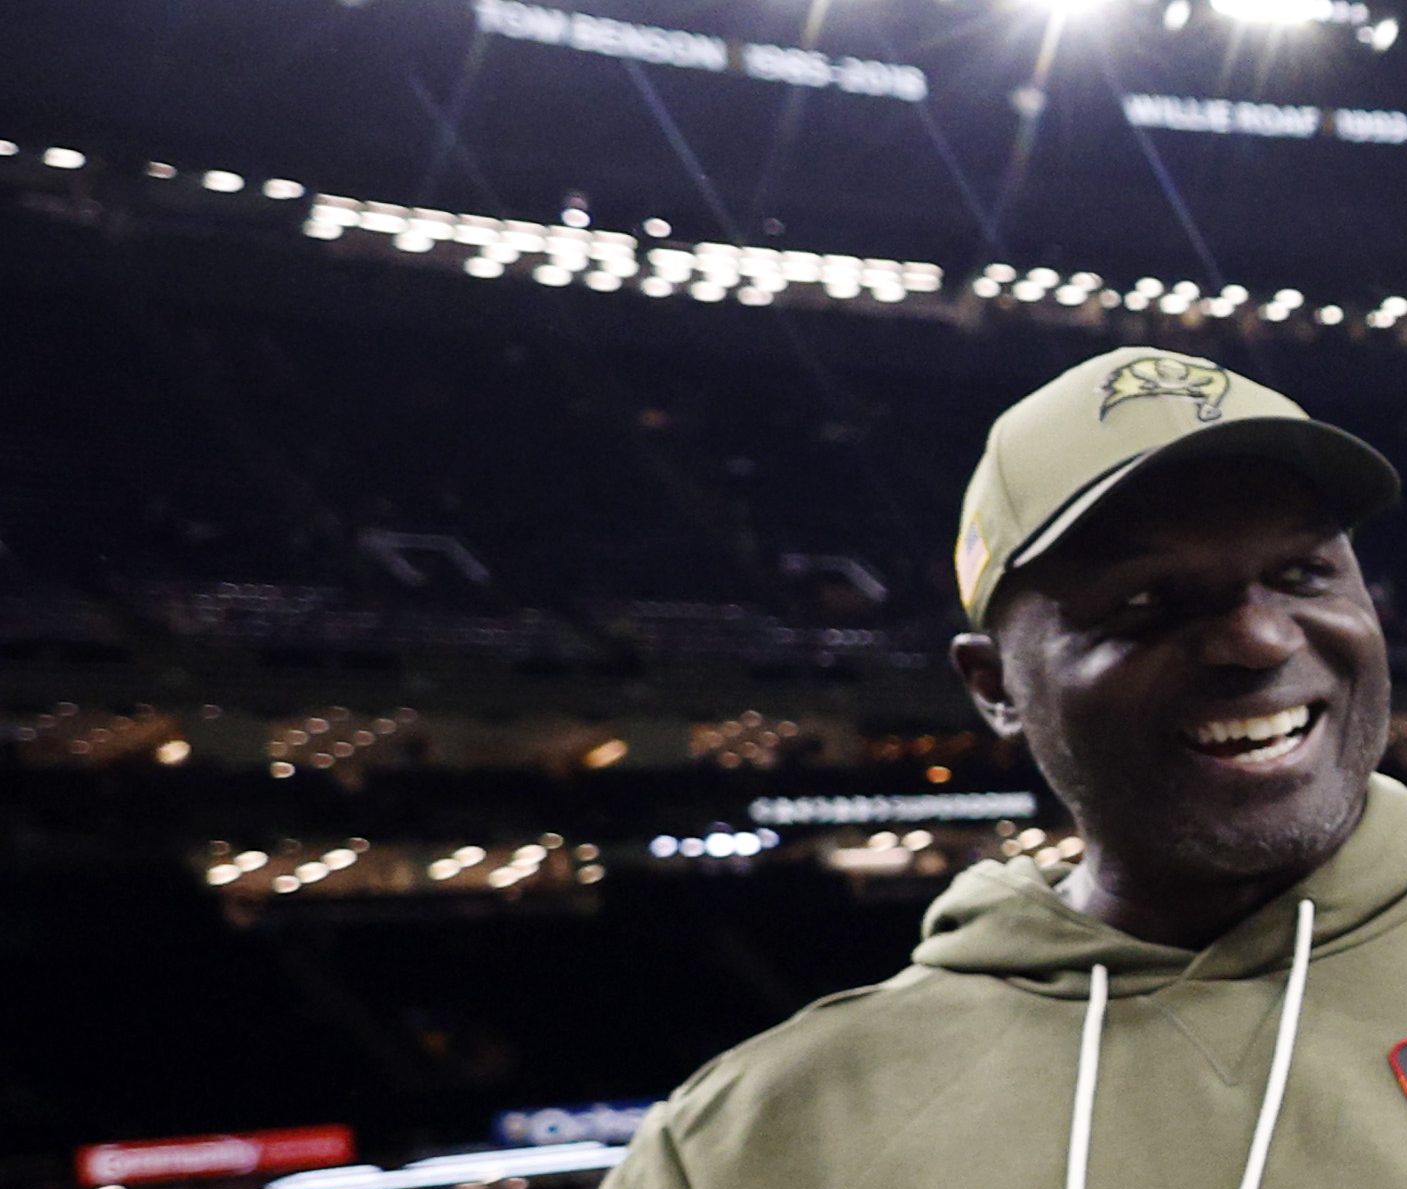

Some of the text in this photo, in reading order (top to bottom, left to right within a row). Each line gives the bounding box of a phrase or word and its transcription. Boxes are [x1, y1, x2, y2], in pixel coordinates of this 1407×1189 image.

[569, 12, 727, 71] BENSON
[1124, 92, 1231, 134] WILLIE
[1233, 101, 1319, 138] ROAF
